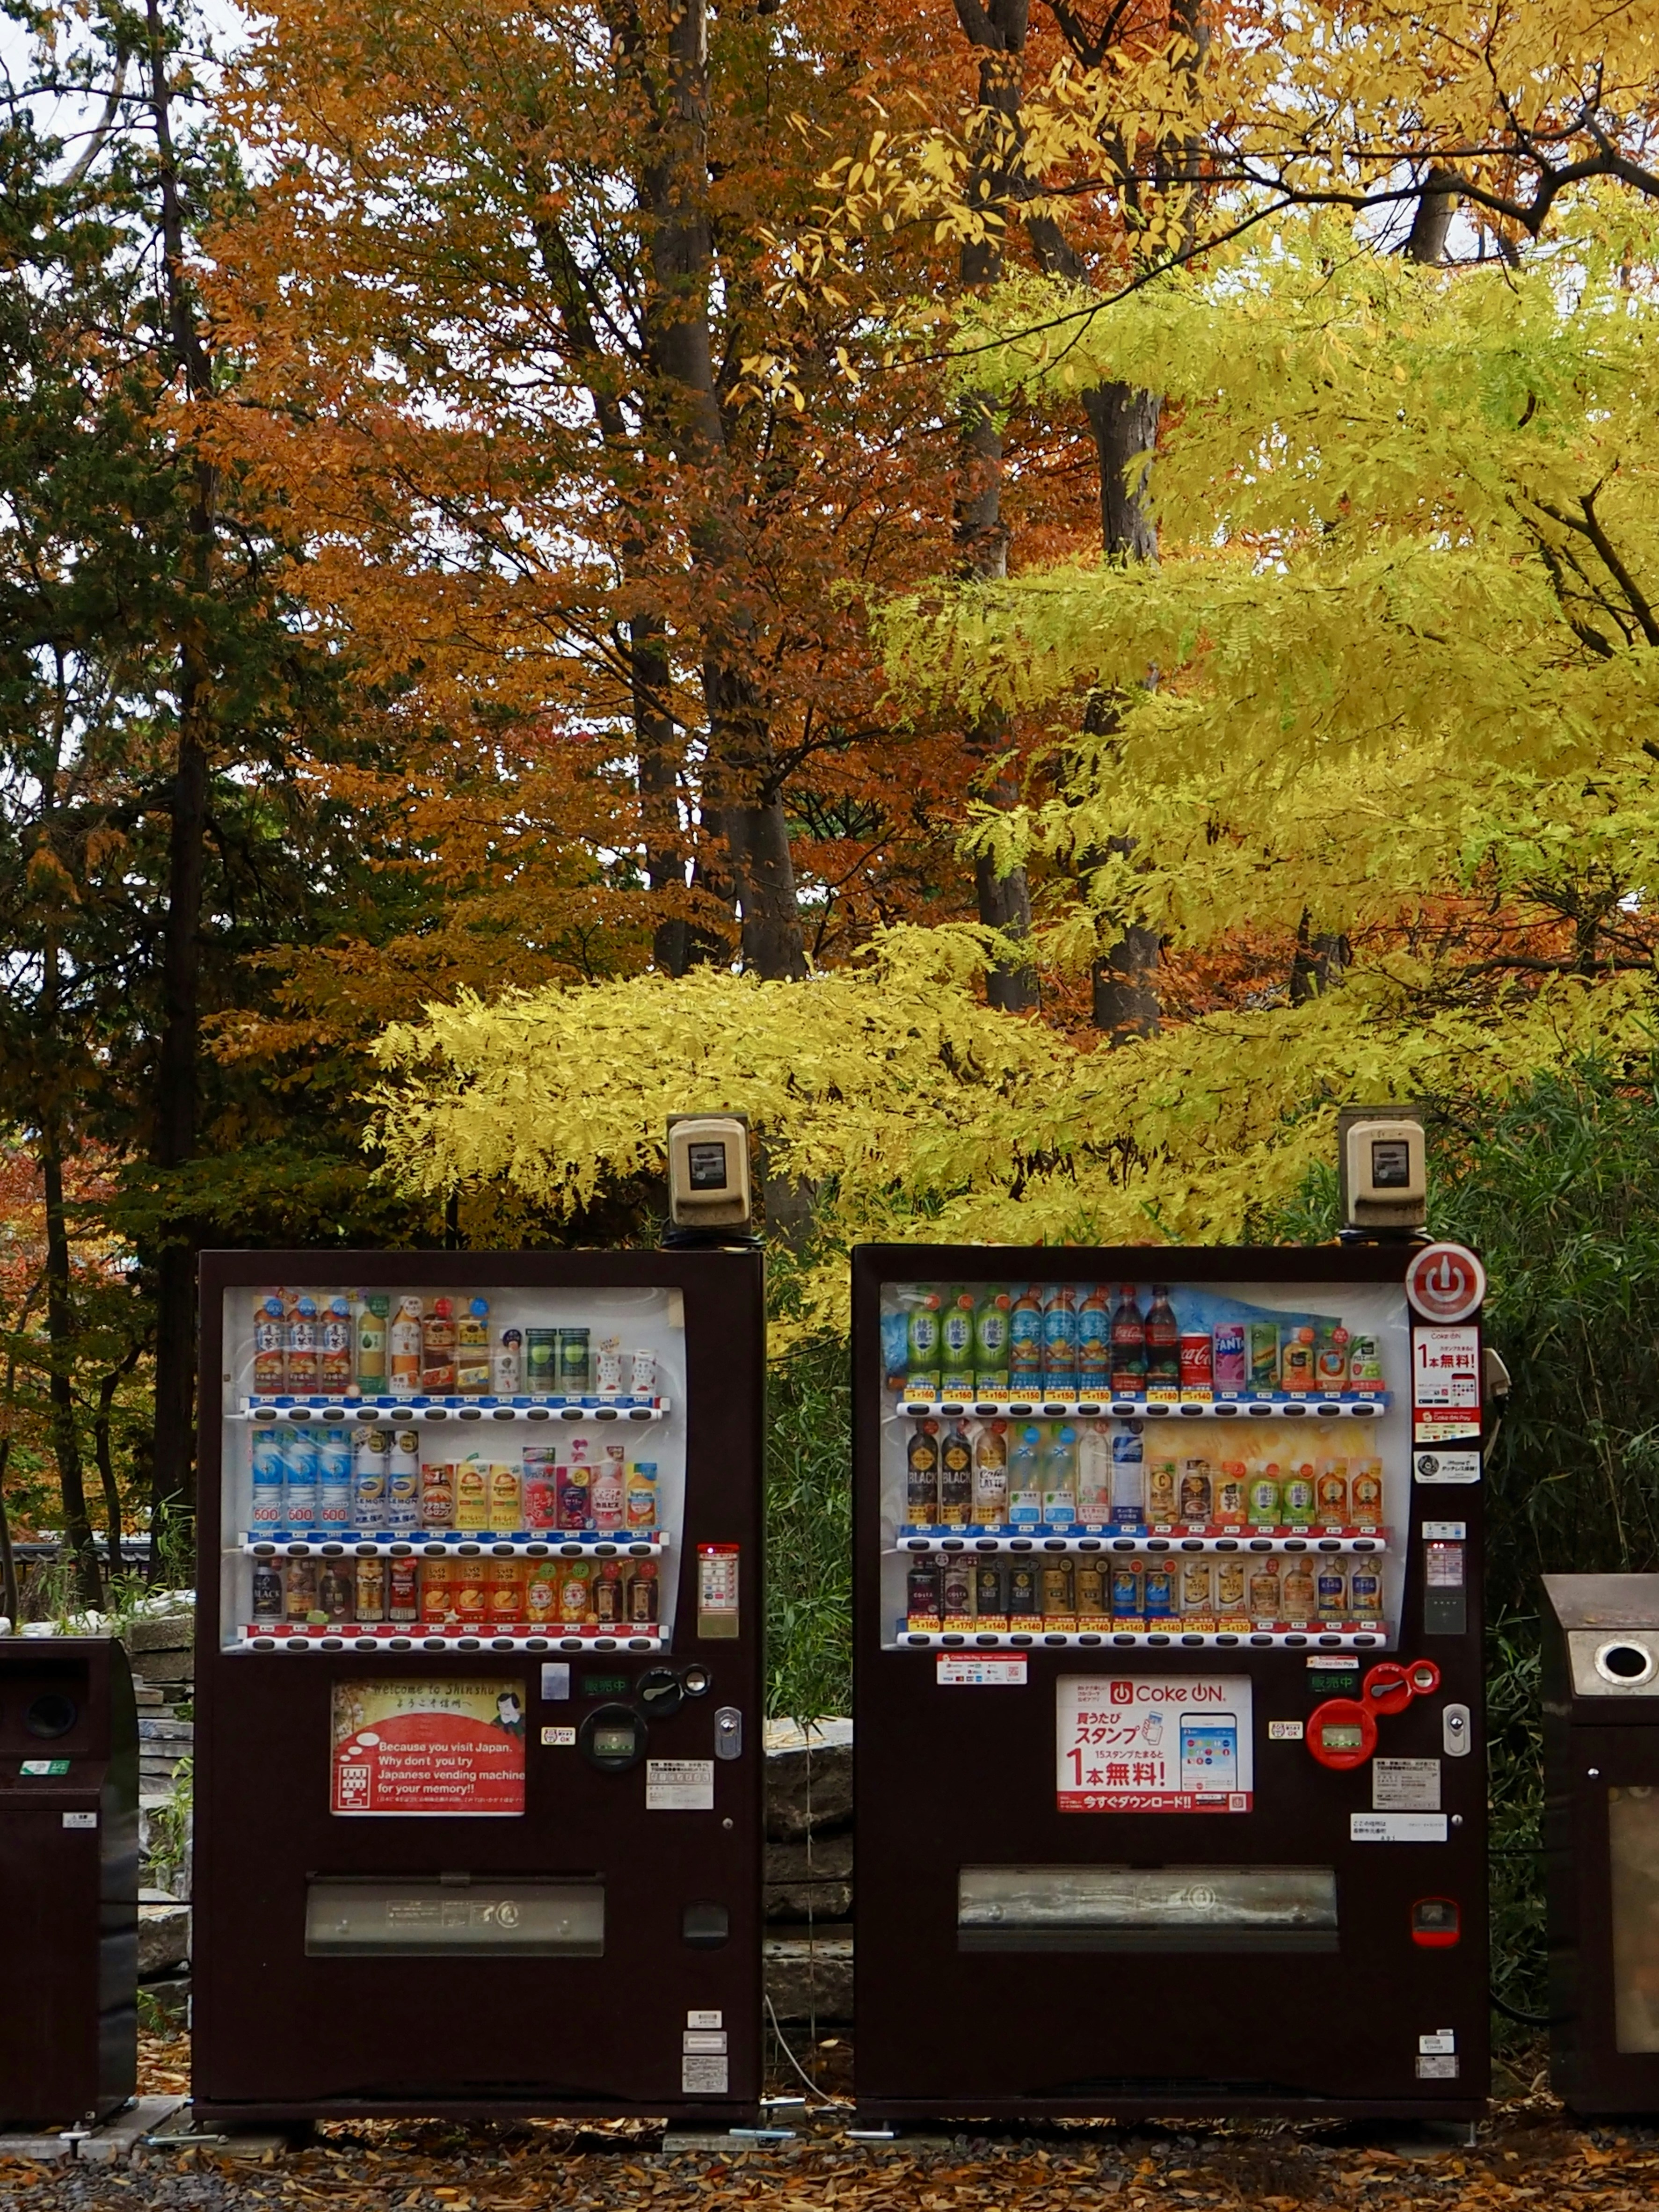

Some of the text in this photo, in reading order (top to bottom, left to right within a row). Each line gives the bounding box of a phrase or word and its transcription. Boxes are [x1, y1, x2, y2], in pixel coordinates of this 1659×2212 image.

[254, 1509, 278, 1520] 600
[289, 1509, 313, 1520] 600
[322, 1509, 346, 1520] 600
[374, 1684, 423, 1696] Welcome
[429, 1684, 441, 1695] to
[1136, 1685, 1187, 1702] Coke
[396, 1698, 473, 1709] ようこそ信州へ
[1077, 1712, 1121, 1725] 買うたび
[1074, 1725, 1140, 1745] スタンプ
[378, 1742, 513, 1754] Because you visit Japan.
[1095, 1749, 1164, 1760] 15スタンプたまると
[378, 1756, 402, 1768] Why
[435, 1758, 456, 1768] you
[457, 1757, 473, 1768] try
[1066, 1747, 1165, 1787] 1本無料!
[378, 1770, 525, 1782] Japanese vending machine
[378, 1784, 475, 1796] for your memory!!
